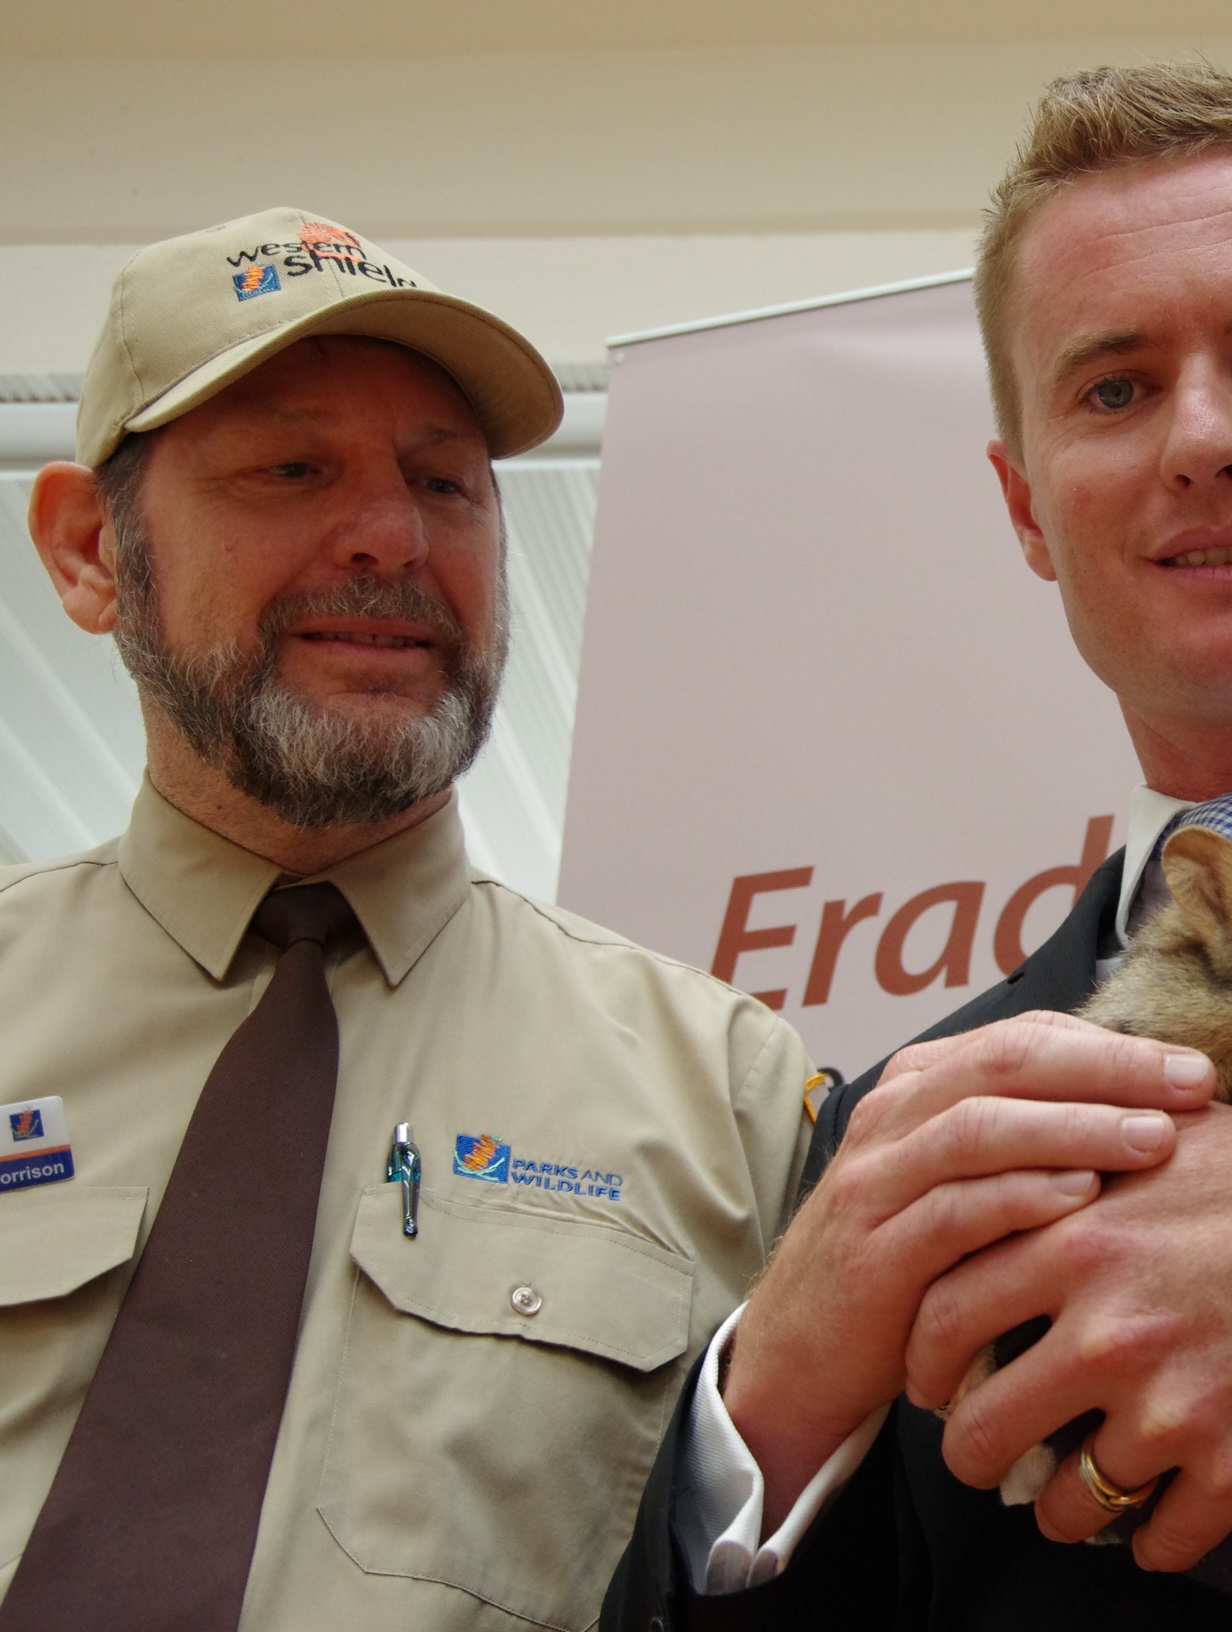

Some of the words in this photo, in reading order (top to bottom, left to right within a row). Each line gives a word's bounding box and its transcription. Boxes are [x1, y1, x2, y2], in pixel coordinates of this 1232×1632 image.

[226, 240, 367, 268] western
[511, 1159, 579, 1178] PARKS
[580, 1169, 624, 1187] AND
[511, 1172, 622, 1201] WILDLIFE
